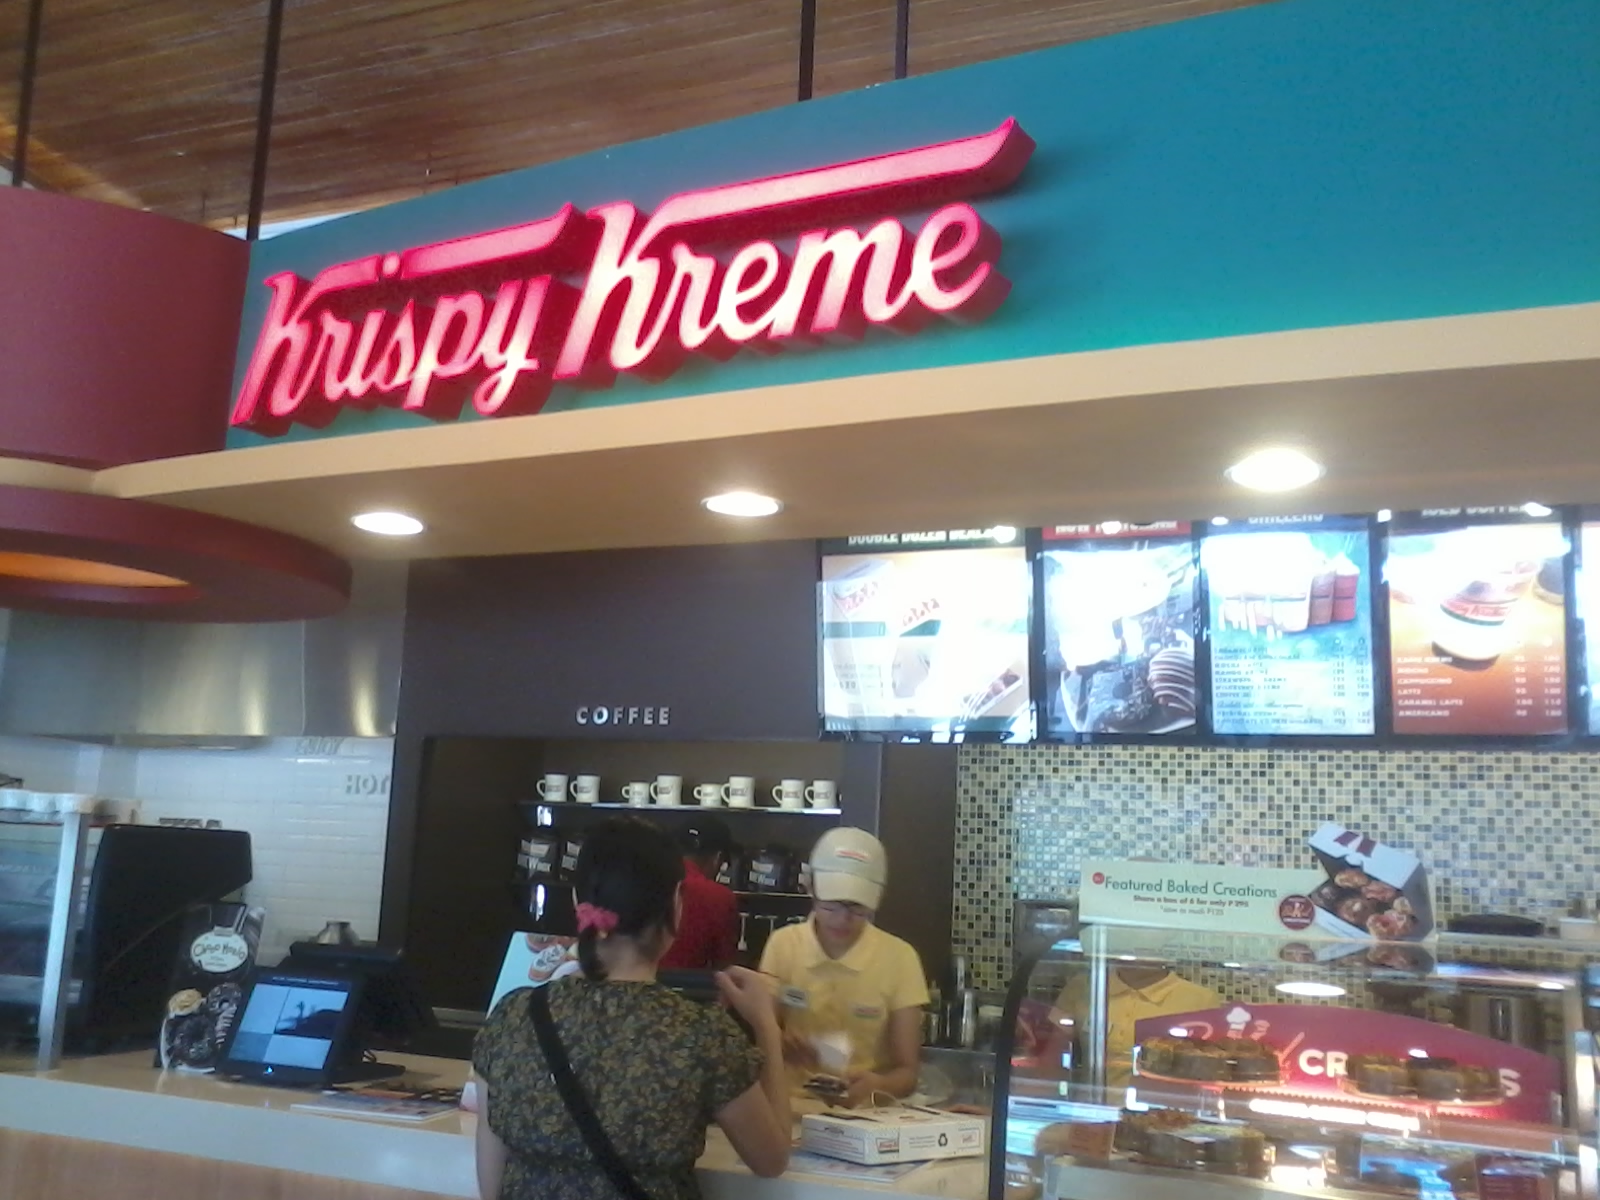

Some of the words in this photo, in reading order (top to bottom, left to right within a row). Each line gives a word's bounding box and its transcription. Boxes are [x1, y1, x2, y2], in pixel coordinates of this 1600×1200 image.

[230, 202, 576, 427] Krispy
[553, 116, 1020, 382] Kreme
[575, 706, 671, 726] COFFEE
[1104, 876, 1163, 893] Featured
[1167, 877, 1209, 895] Baked
[1213, 881, 1278, 898] Creations
